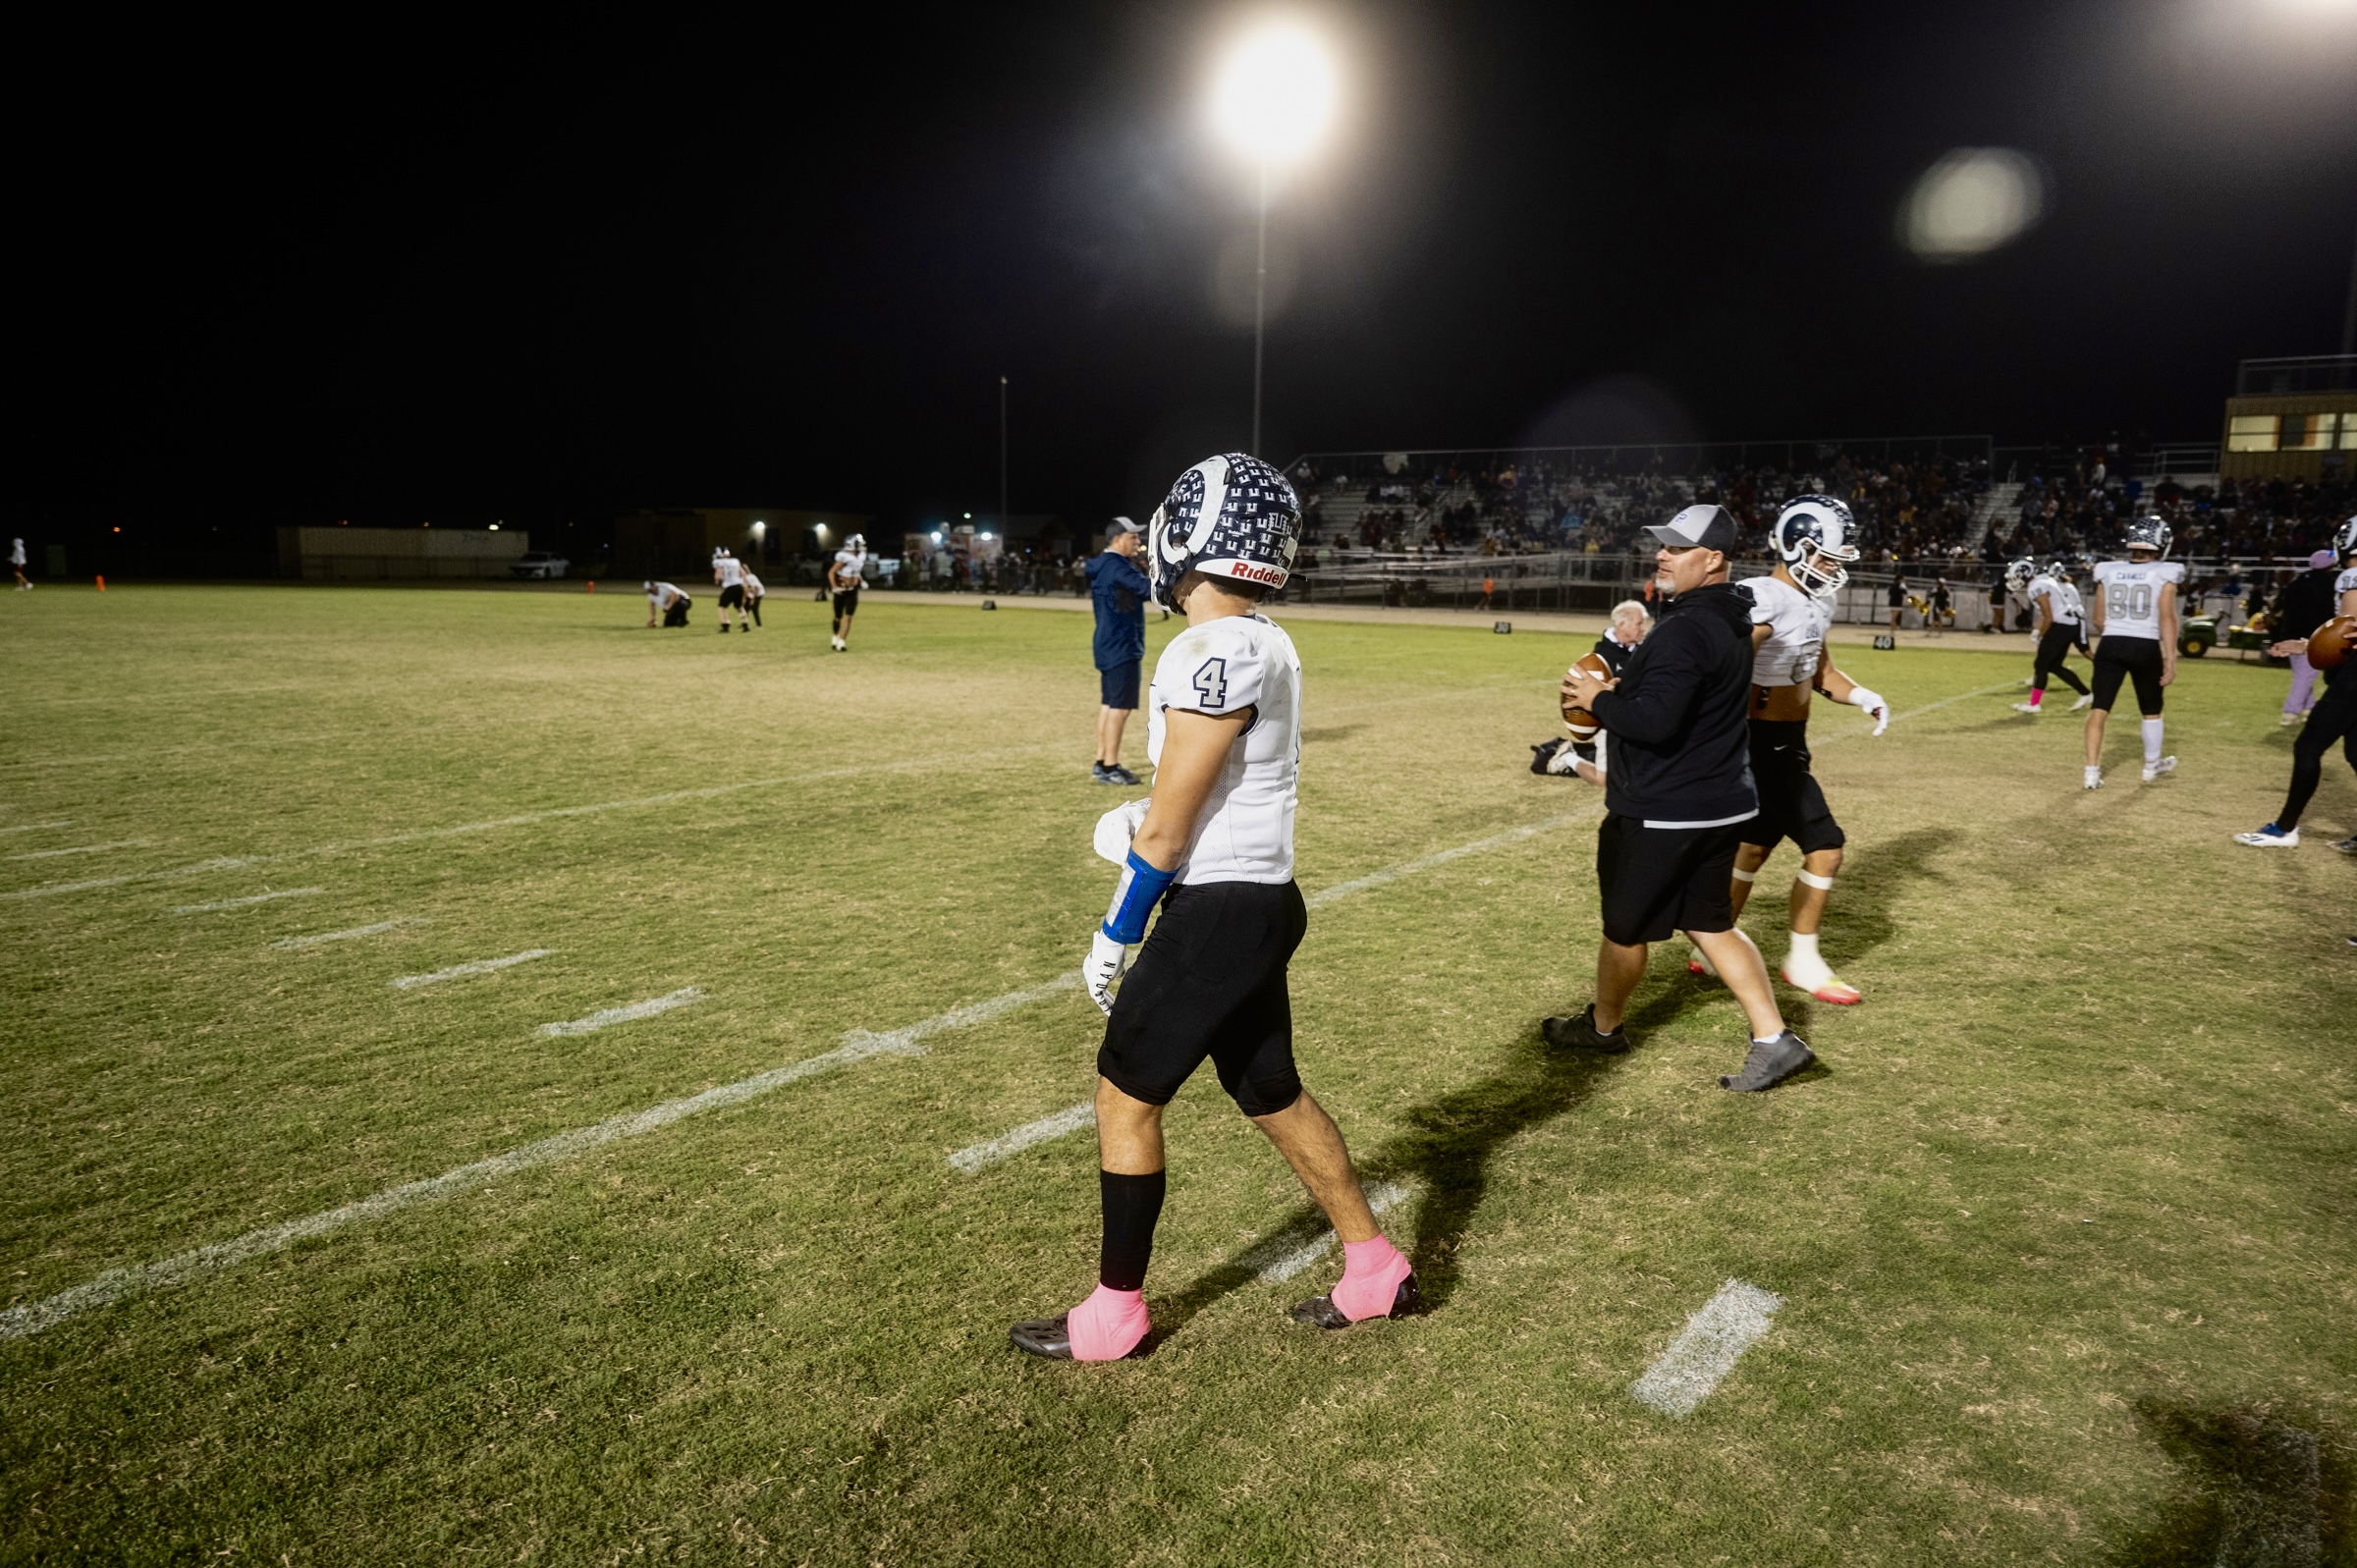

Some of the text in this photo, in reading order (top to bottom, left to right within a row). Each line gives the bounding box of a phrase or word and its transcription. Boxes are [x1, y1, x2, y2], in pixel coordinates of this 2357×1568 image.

[1231, 562, 1287, 586] Riddell
[2108, 583, 2152, 620] 80
[1875, 636, 1891, 649] 40
[1192, 657, 1228, 708] 4
[1095, 960, 1116, 1012] JORDAN
